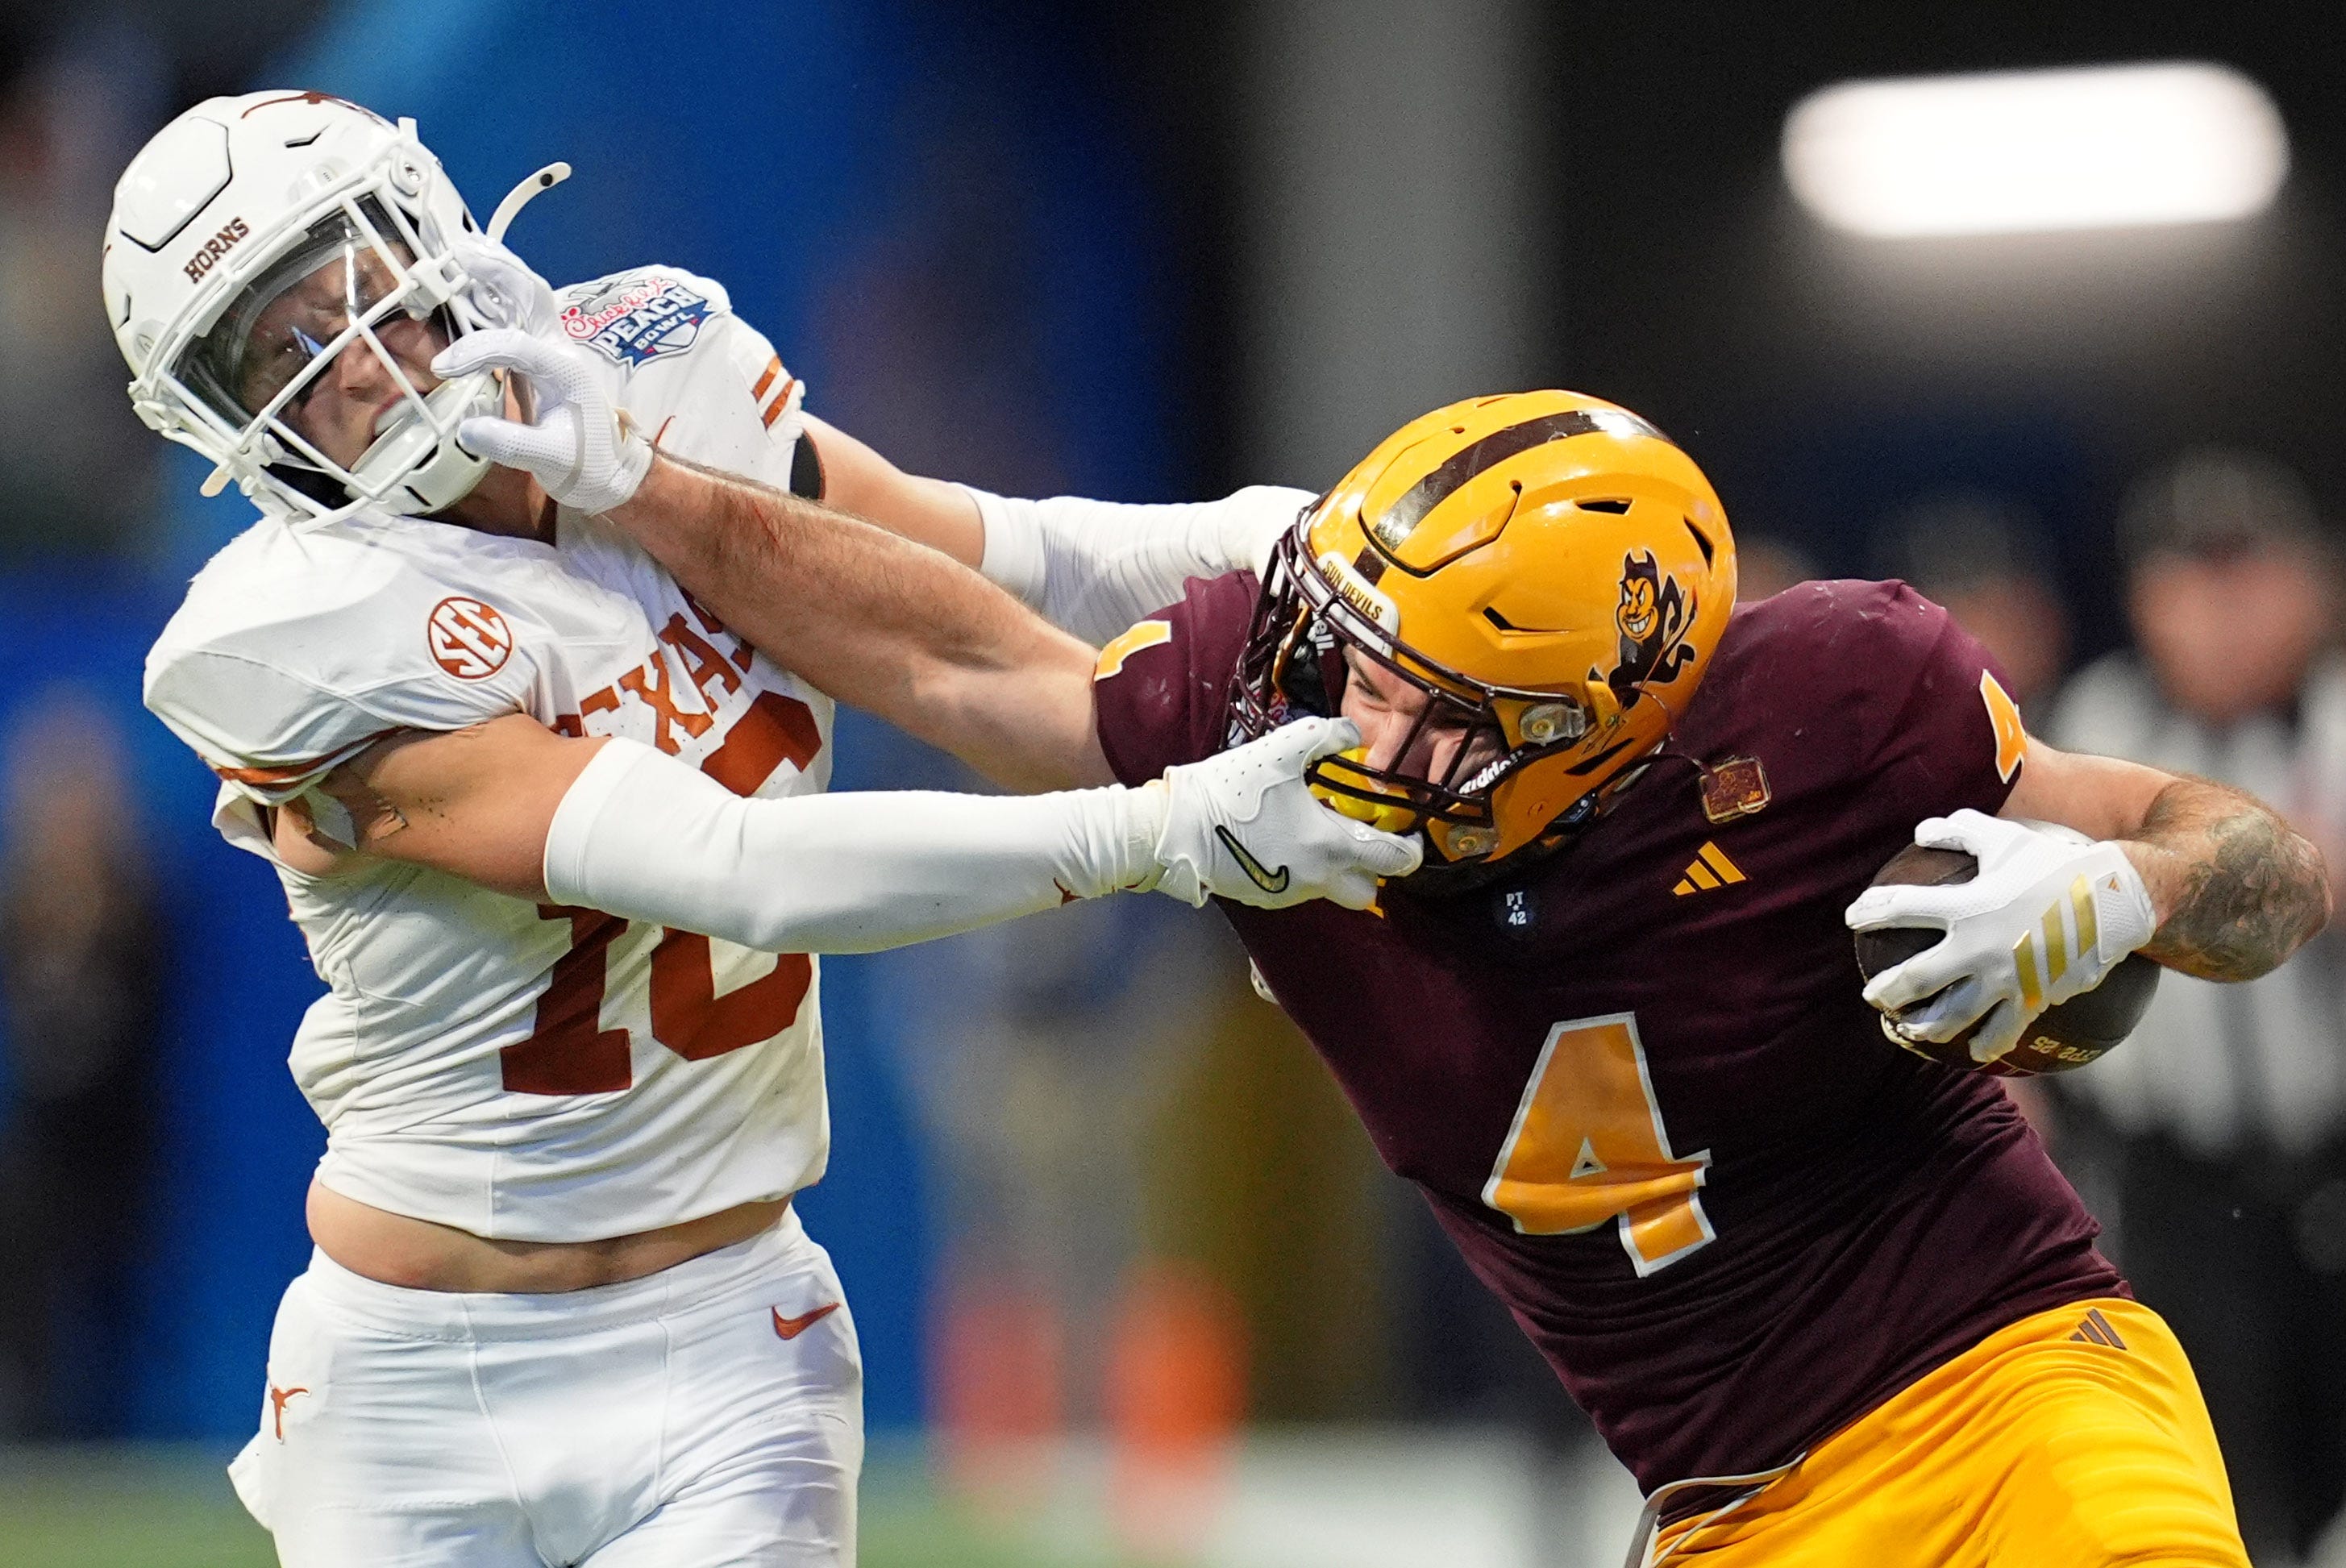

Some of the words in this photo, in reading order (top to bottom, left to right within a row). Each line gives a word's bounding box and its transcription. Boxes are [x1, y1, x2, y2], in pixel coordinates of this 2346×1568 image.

[183, 216, 249, 284] HORNS
[592, 285, 706, 358] PEACH
[634, 311, 696, 350] BOWL
[1323, 560, 1345, 588] SUN
[1342, 581, 1383, 621] DEVILS
[429, 597, 512, 679] SEC
[1505, 891, 1524, 907] PT
[1508, 910, 1527, 925] 42
[1480, 1010, 1717, 1279] 4
